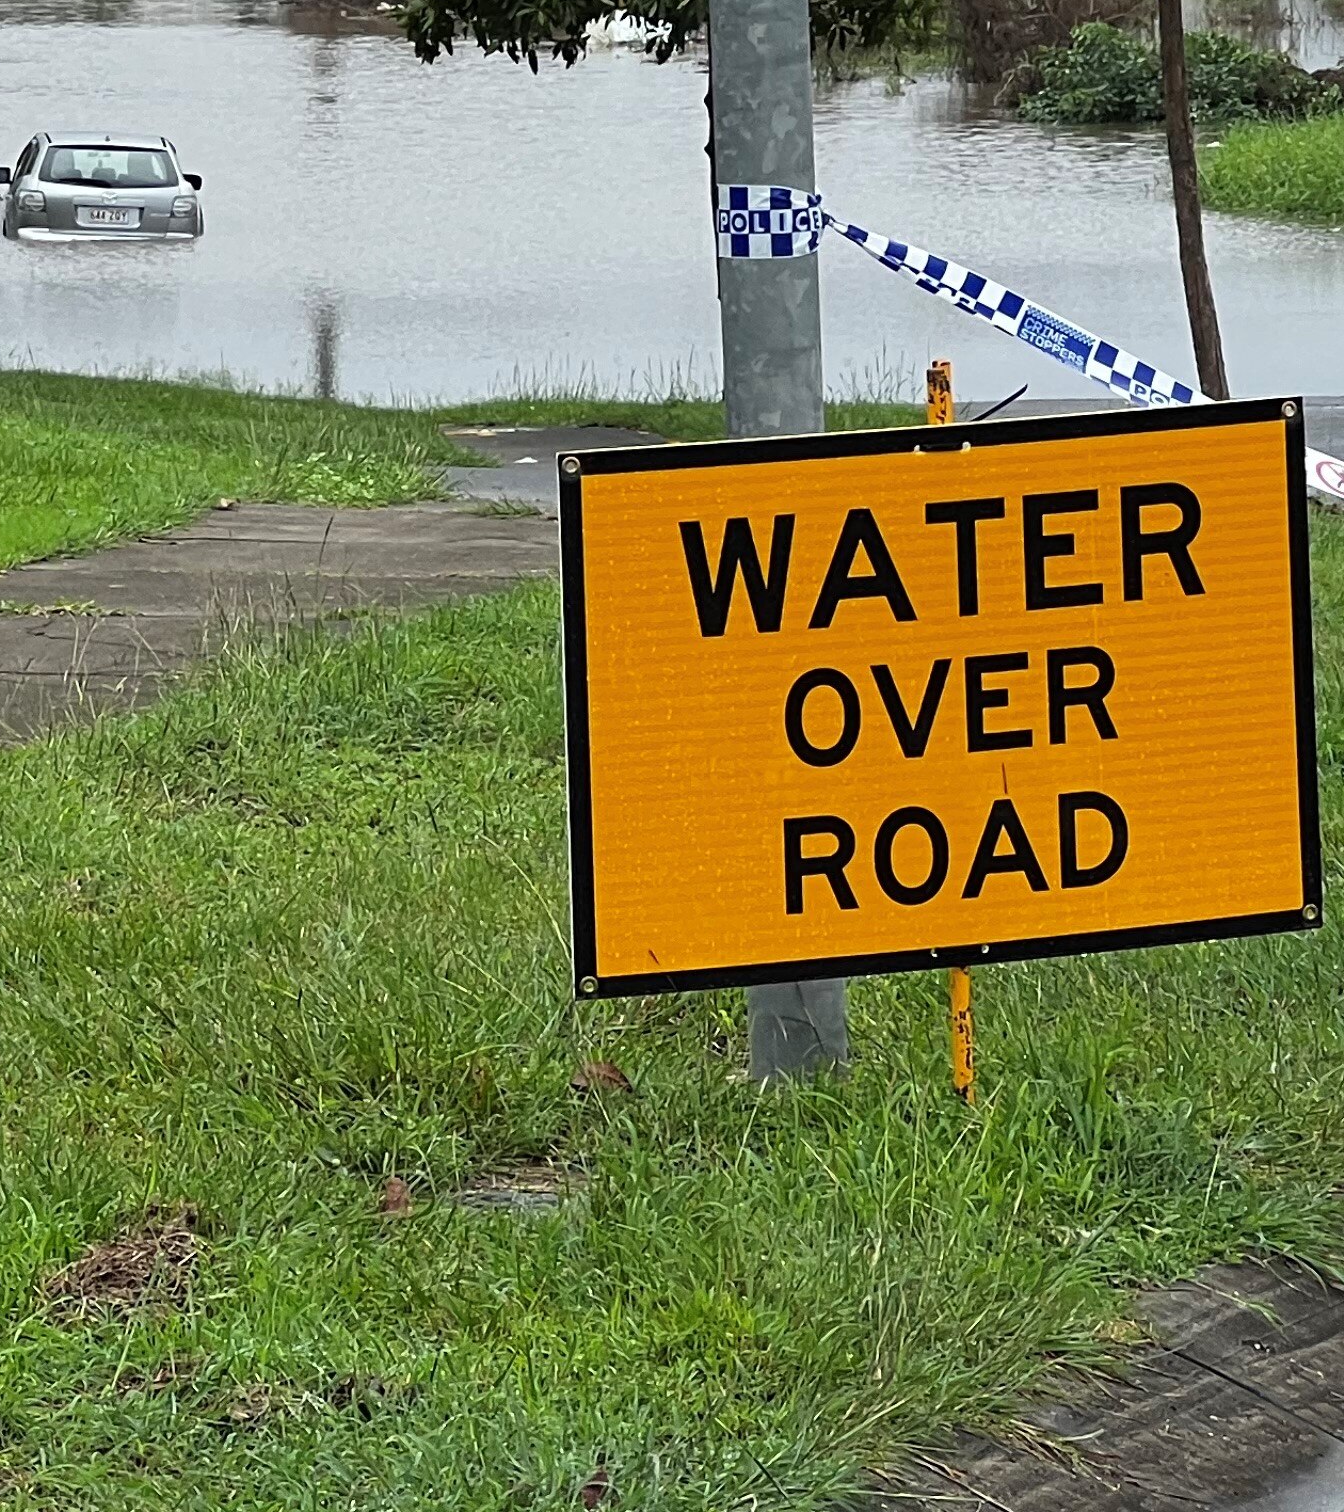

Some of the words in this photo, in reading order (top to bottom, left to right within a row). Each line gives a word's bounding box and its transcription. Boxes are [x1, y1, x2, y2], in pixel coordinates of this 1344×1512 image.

[720, 210, 820, 233] POLICE
[1019, 327, 1085, 367] STOPPERS
[1023, 316, 1069, 348] CRIME
[677, 482, 1206, 638] WATER
[785, 645, 1118, 768] OVER
[783, 791, 1129, 915] ROAD
